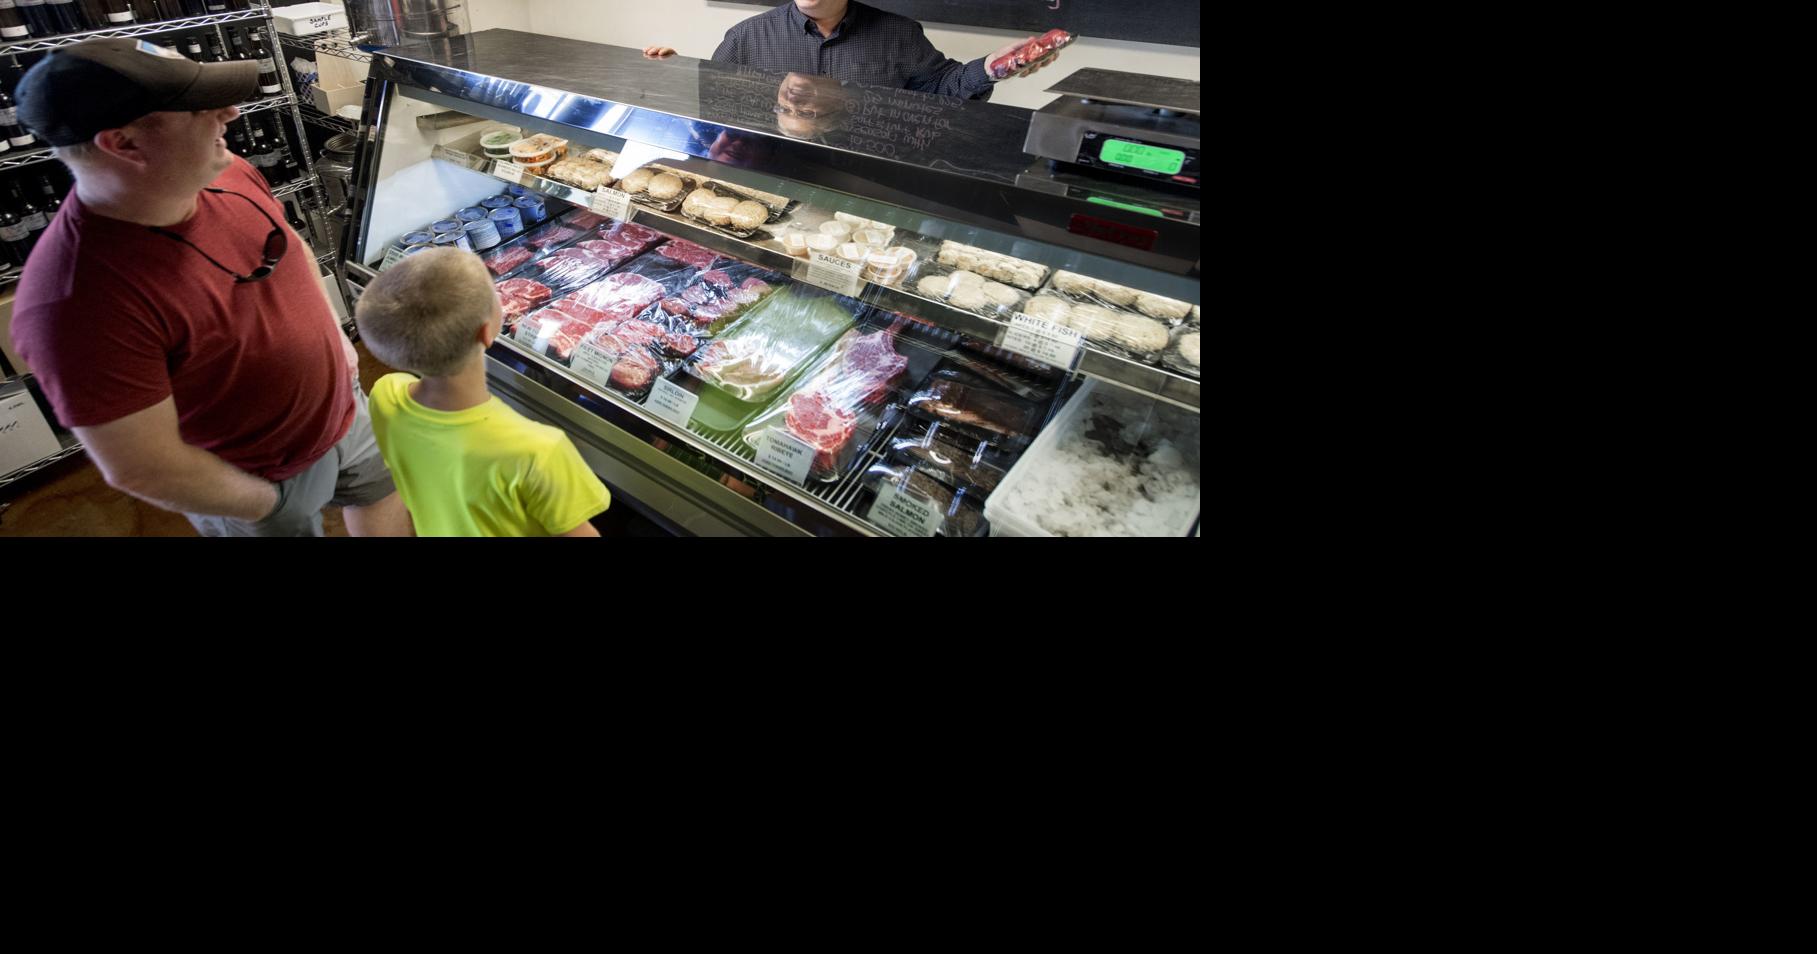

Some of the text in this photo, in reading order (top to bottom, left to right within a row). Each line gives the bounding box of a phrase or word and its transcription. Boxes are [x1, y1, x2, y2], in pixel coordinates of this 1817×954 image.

[817, 254, 852, 269] SAUCES
[1014, 313, 1078, 337] WHITE FISH
[890, 500, 925, 524] SALMON
[893, 493, 929, 517] SMOKED
